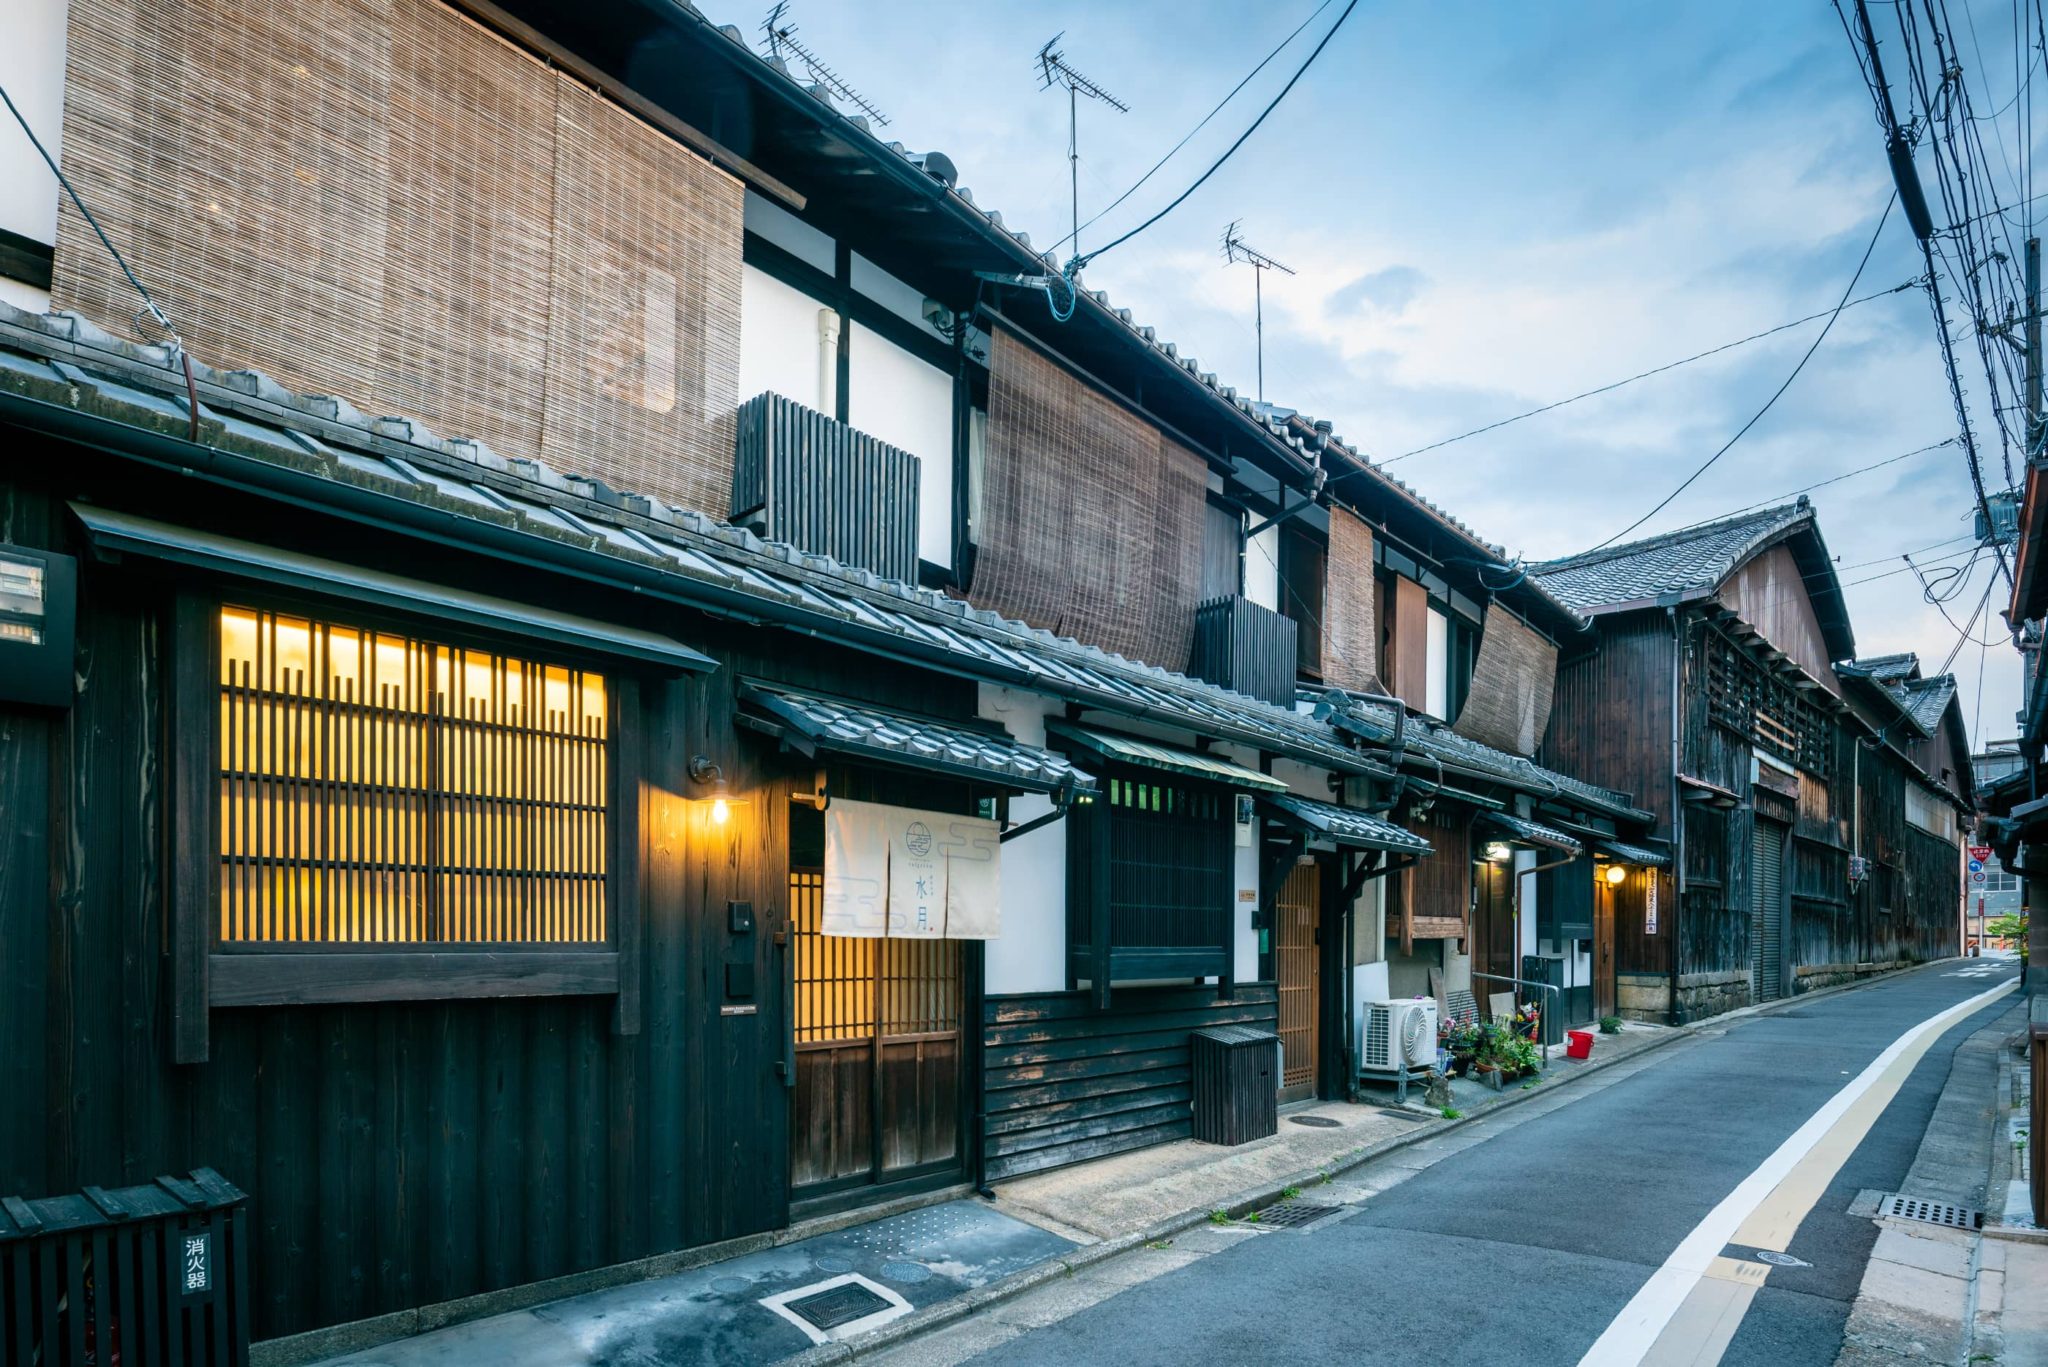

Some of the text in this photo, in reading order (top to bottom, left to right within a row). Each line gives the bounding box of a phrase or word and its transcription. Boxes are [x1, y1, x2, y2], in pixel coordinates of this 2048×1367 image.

[916, 875, 928, 931] 水月
[186, 1238, 206, 1289] 消火器
